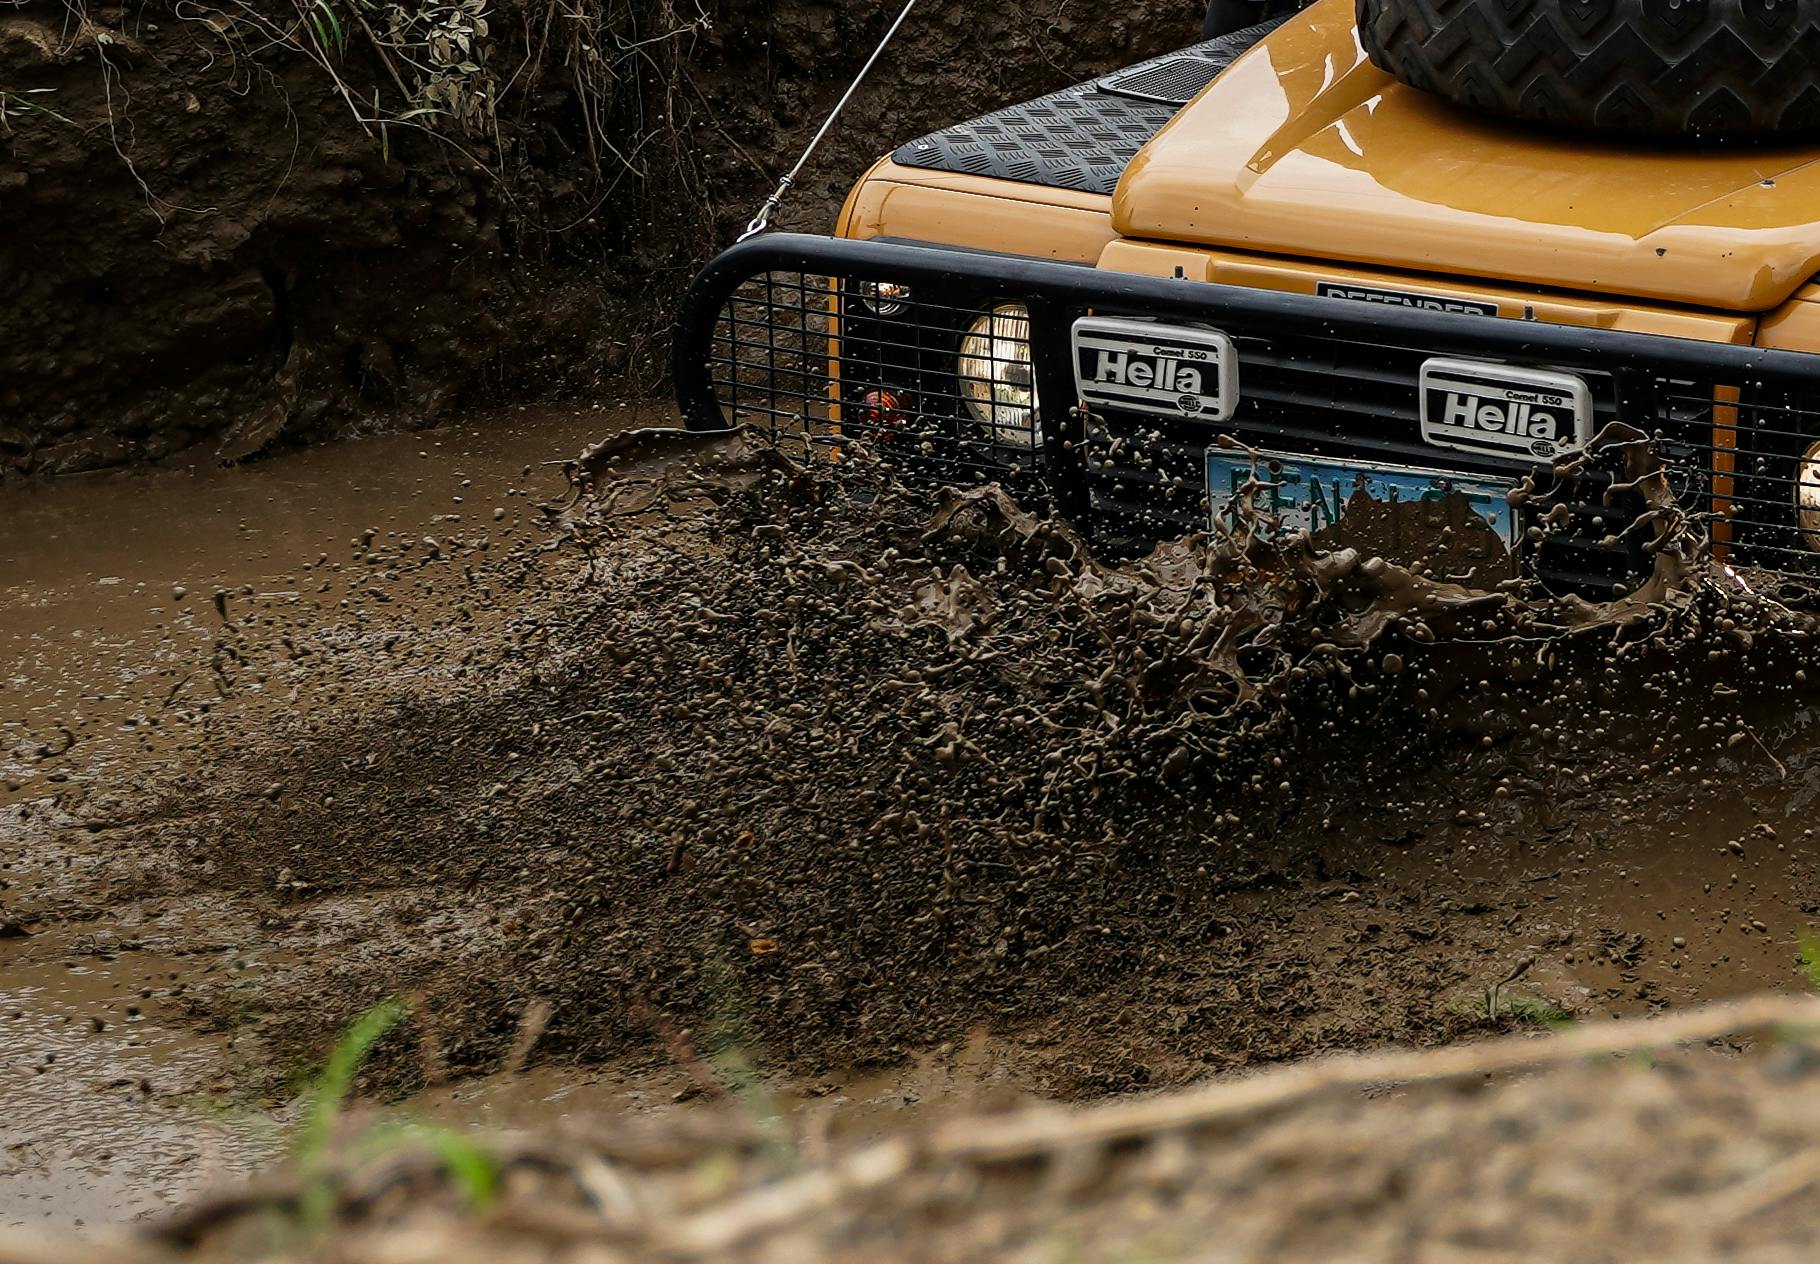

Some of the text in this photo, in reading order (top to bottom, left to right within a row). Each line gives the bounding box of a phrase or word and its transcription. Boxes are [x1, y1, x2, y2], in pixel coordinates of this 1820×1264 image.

[1153, 346, 1207, 360] Comet 550
[1096, 350, 1202, 394] Hella
[1505, 391, 1562, 406] Comet 550
[1443, 392, 1556, 440] Hella
